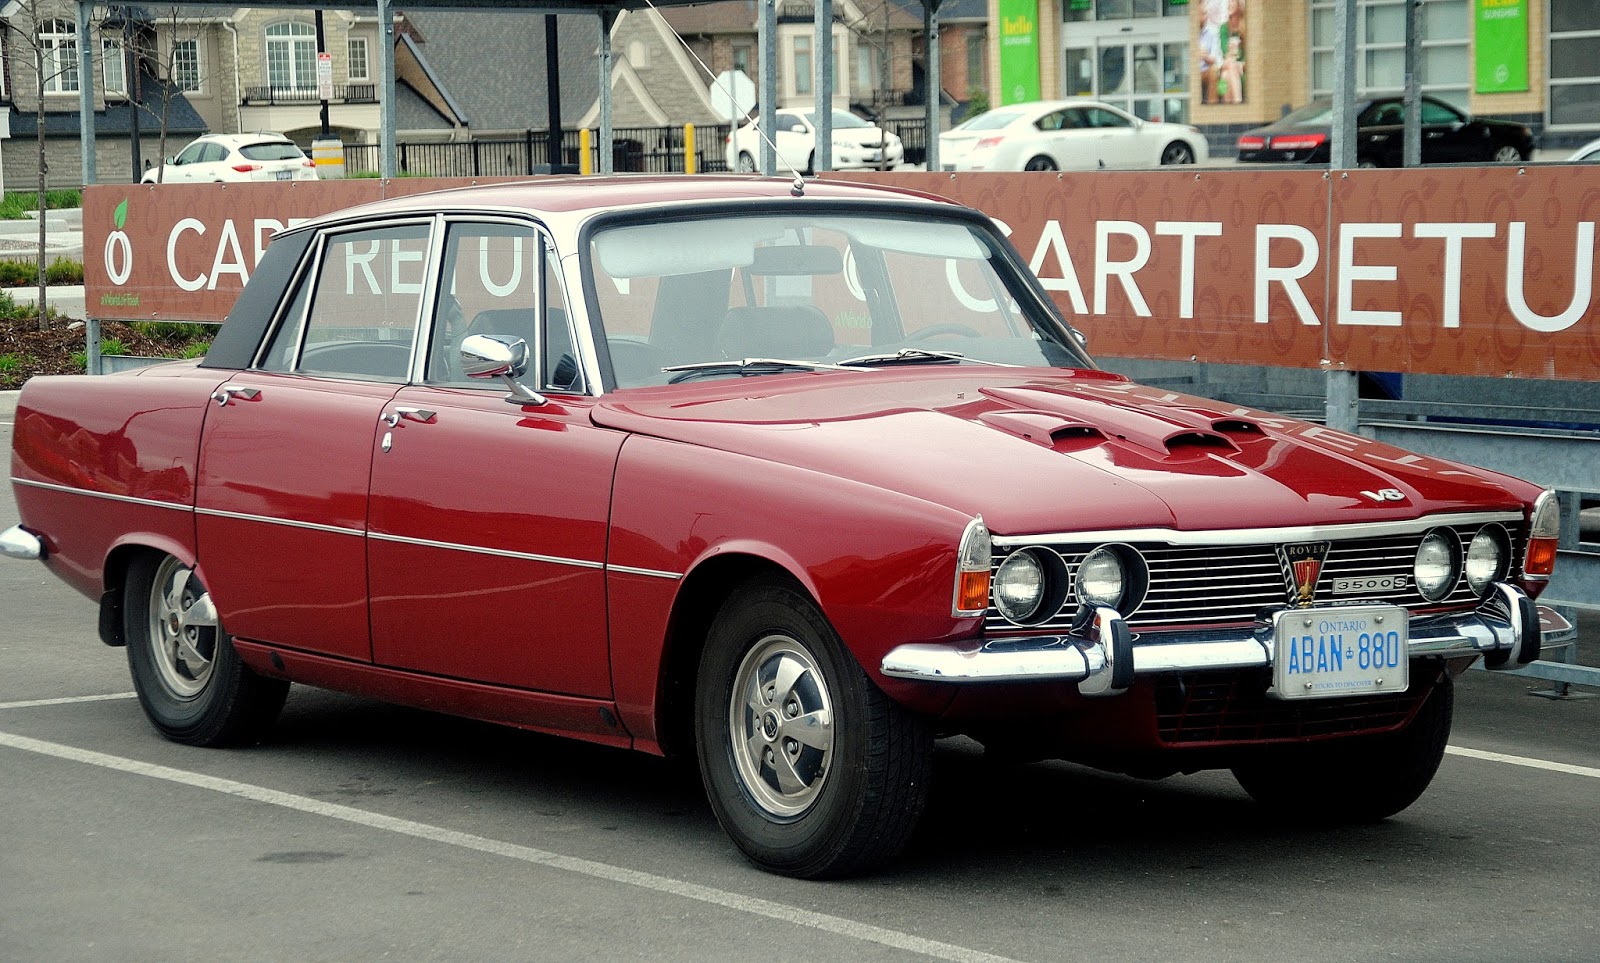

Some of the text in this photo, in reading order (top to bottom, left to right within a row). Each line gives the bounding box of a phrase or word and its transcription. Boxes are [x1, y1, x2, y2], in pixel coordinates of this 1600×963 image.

[1360, 488, 1406, 503] V8
[1289, 545, 1326, 556] ROVER
[1337, 577, 1407, 590] 3500S
[1319, 620, 1367, 635] ONTARIO
[1288, 631, 1399, 675] ABAN 880
